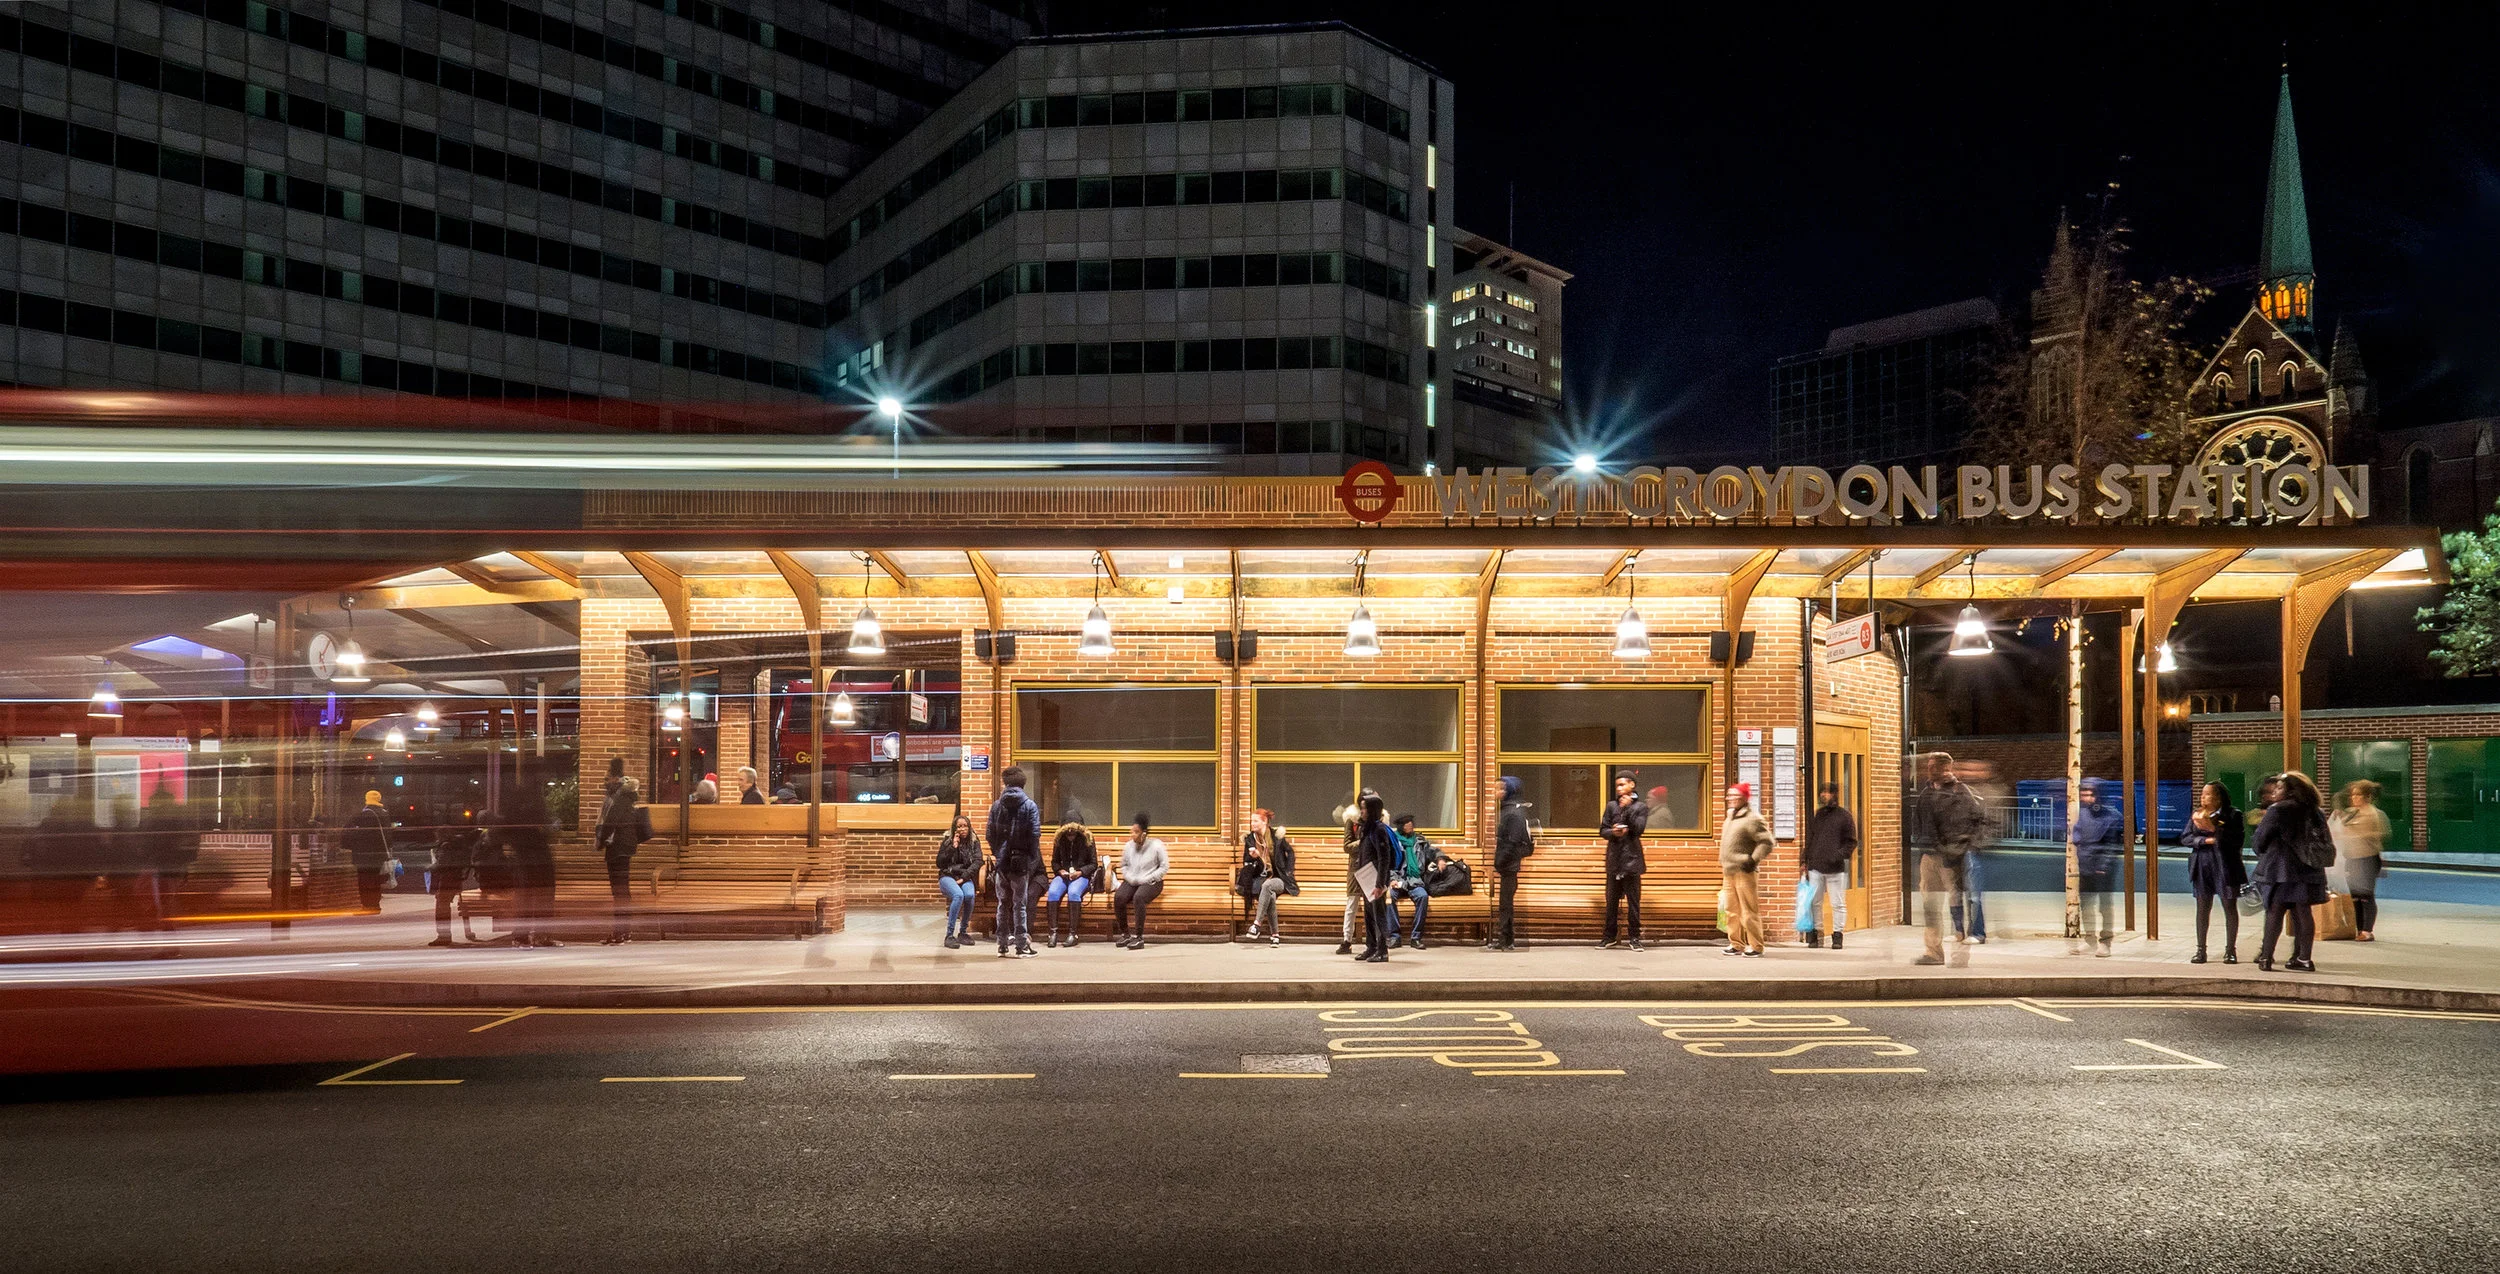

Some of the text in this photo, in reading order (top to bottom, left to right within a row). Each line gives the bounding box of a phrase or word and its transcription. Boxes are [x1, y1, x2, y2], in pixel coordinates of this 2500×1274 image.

[1356, 487, 1382, 496] BUSES
[1433, 463, 2370, 521] WEST CROYDON BUS STATION
[1861, 629, 1870, 643] B3
[796, 751, 812, 763] Go
[1318, 1010, 1561, 1067] STOP
[1638, 1014, 1919, 1058] BUS
